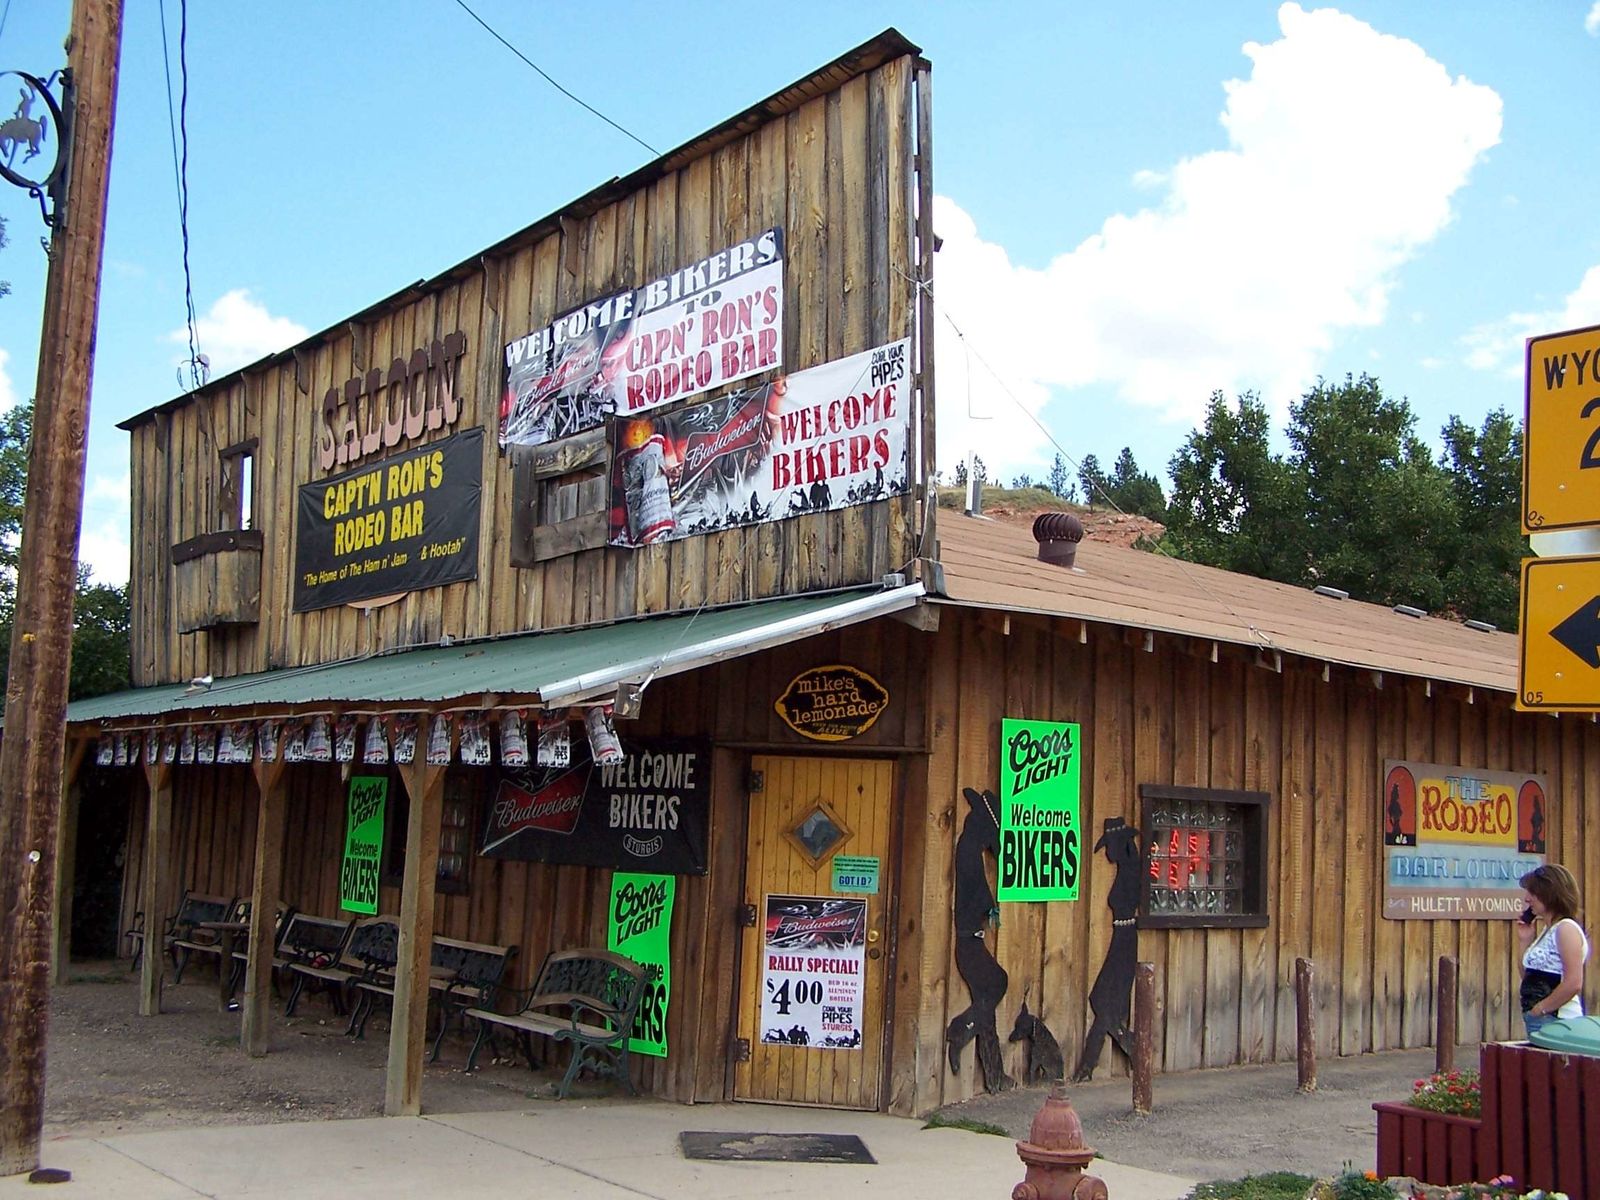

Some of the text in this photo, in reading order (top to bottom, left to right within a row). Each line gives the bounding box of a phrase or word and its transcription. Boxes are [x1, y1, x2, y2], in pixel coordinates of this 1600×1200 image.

[506, 231, 777, 368] WELCOME BIKERS
[683, 290, 722, 316] TO
[625, 285, 778, 373] CAPN' RON'S
[626, 328, 778, 411] RODEO BAR
[871, 357, 904, 387] PIPES
[321, 330, 466, 471] SALOON
[780, 384, 897, 446] WELCOME
[686, 412, 761, 471] Budweiser
[772, 428, 890, 491] BIKERS
[323, 449, 444, 520] CAPT'N RON'S
[334, 500, 424, 556] RODEO BAR
[1528, 510, 1545, 526] 05
[319, 570, 338, 583] Home
[339, 564, 348, 579] of
[349, 562, 362, 576] The
[364, 558, 380, 574] Ham
[391, 553, 408, 567] Jam
[420, 545, 428, 561] &
[798, 675, 856, 693] mike's
[812, 687, 861, 709] hard
[1526, 692, 1543, 703] 05
[792, 700, 879, 725] lemonade
[1008, 727, 1073, 773] Coors
[601, 752, 696, 789] WELCOME
[1012, 753, 1072, 797] LIGHT
[1444, 775, 1491, 801] THE
[494, 791, 581, 829] Budweiser
[609, 793, 681, 831] BIKERS
[1011, 803, 1072, 828] Welcome
[626, 837, 660, 855] STURGIS
[1001, 829, 1078, 889] BIKERS
[342, 857, 378, 905] BIKERS
[839, 876, 855, 885] GOT
[1394, 856, 1449, 879] BAR
[614, 880, 667, 924] Coors
[1466, 897, 1522, 912] WYOMING
[616, 907, 665, 946] LIGHT
[780, 918, 855, 934] Budweiser
[769, 955, 859, 975] RALLY SPECIAL!
[822, 1012, 853, 1024] PIPES
[822, 1023, 853, 1031] STURGIS
